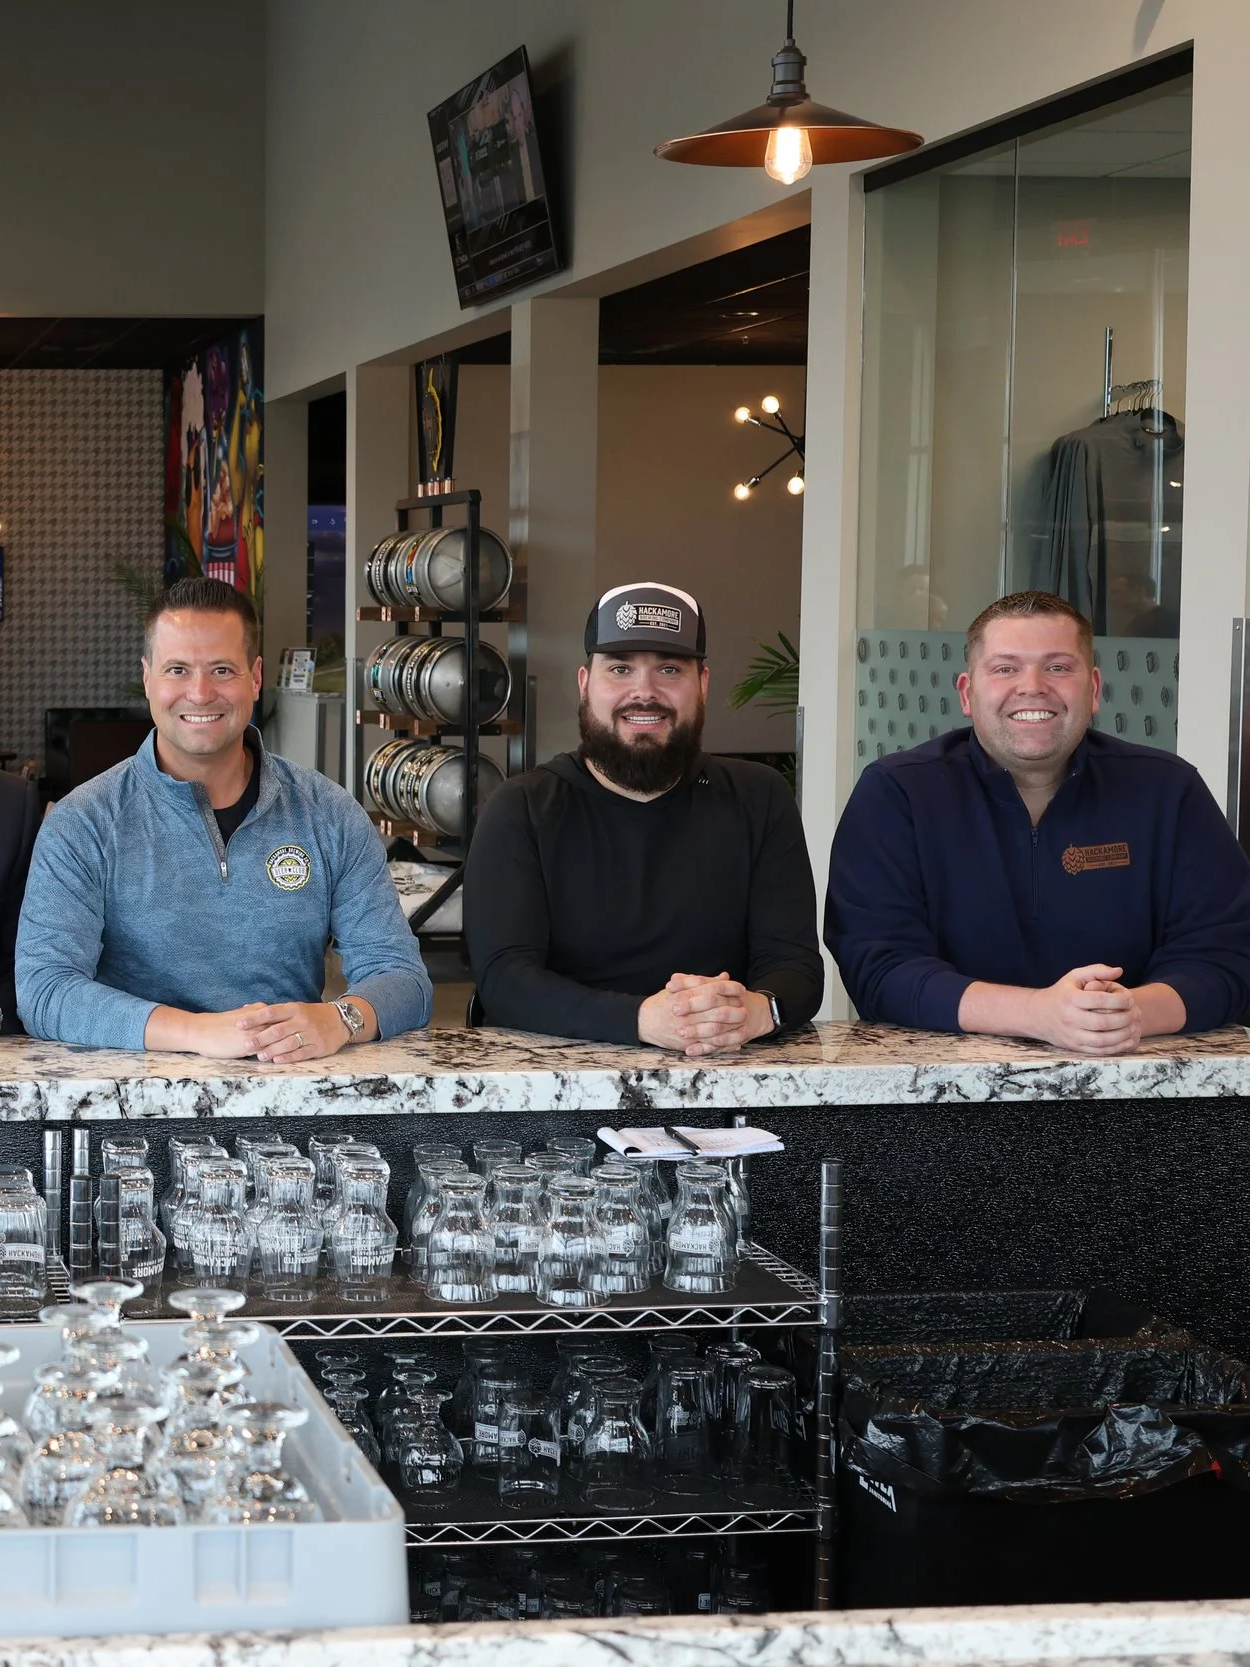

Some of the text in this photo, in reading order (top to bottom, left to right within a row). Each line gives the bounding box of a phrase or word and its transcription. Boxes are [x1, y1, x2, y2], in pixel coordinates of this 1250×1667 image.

[639, 606, 679, 619] HACKAMORE
[1085, 844, 1127, 856] HACKAMORE
[192, 1253, 238, 1267] HACKAMORE
